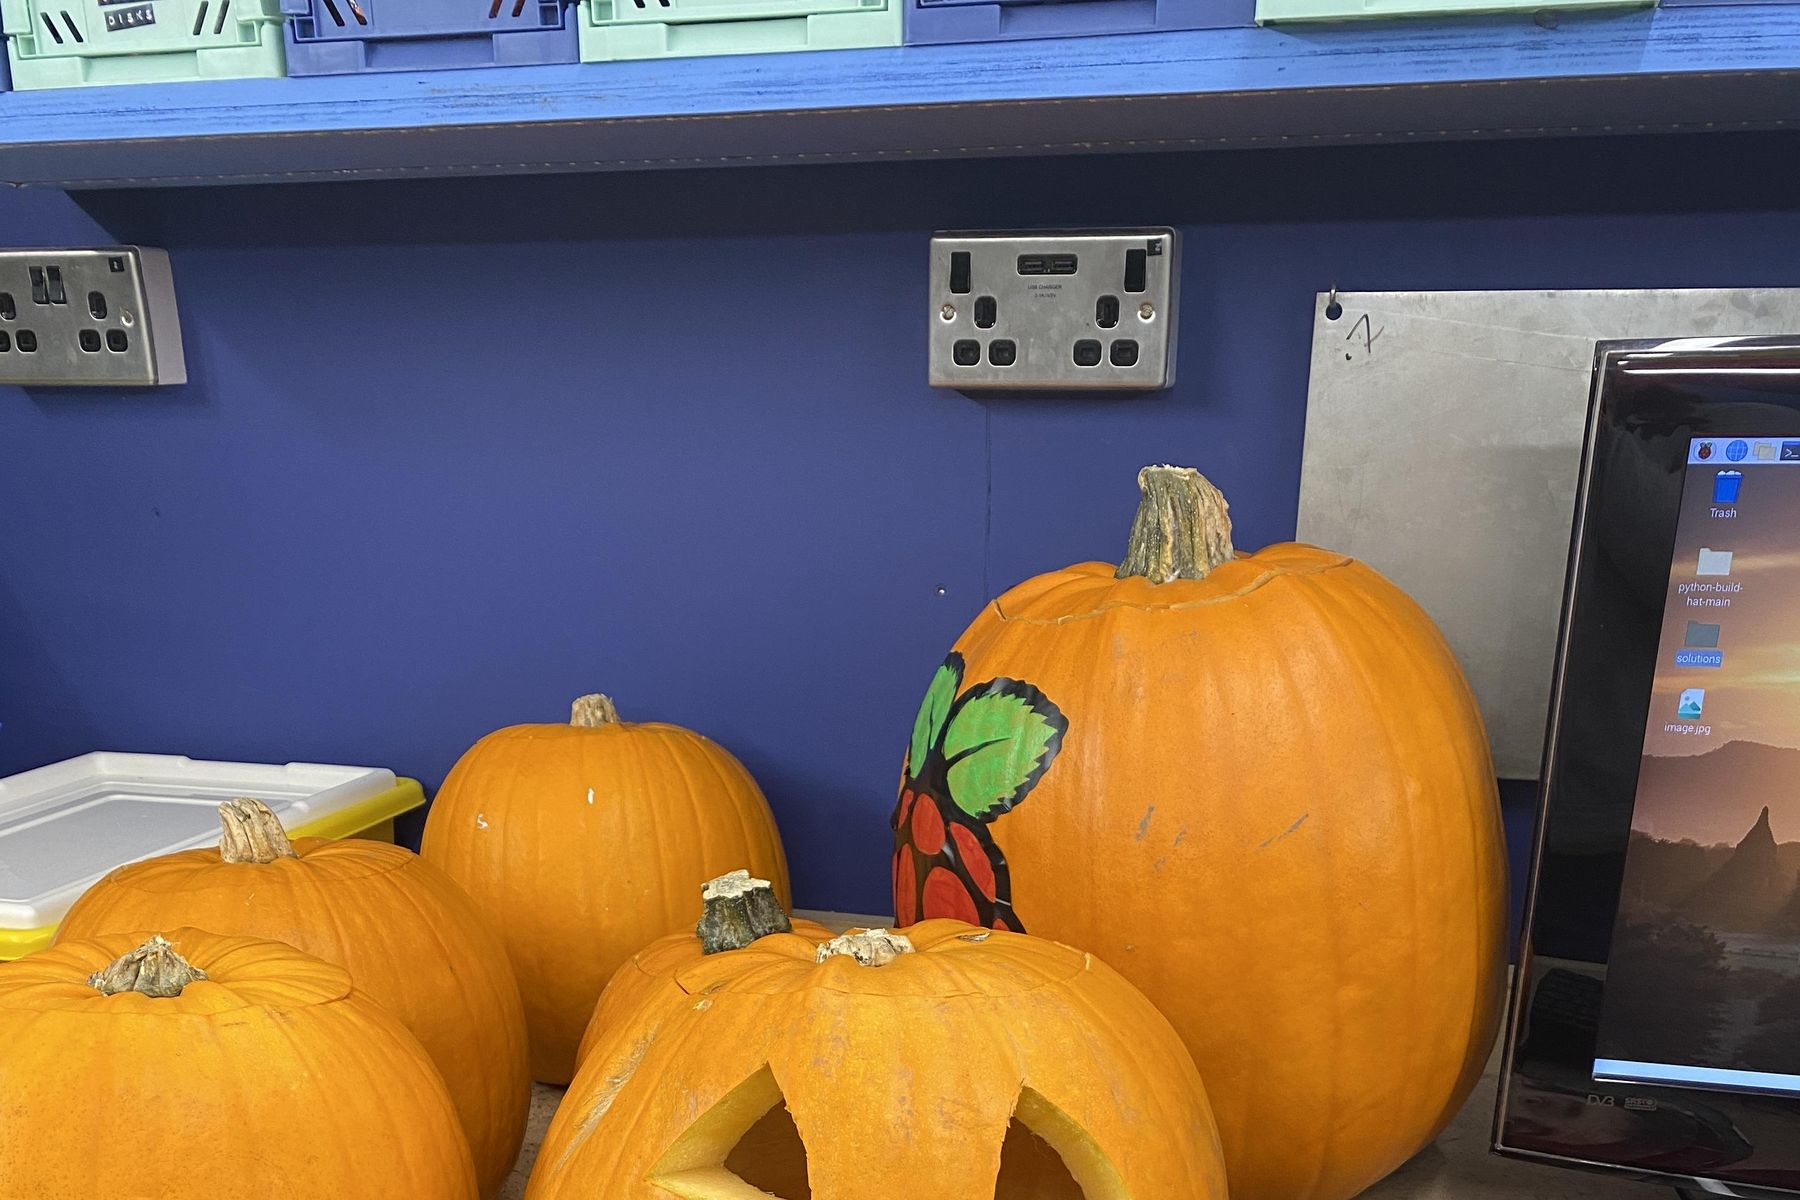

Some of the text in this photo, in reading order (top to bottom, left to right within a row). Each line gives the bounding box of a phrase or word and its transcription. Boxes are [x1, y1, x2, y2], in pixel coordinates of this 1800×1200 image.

[107, 9, 153, 26] DISKS
[1709, 507, 1737, 518] Trash
[1678, 582, 1743, 594] python-build-
[1686, 596, 1731, 607] hat-main
[1676, 653, 1721, 664] solutions
[1664, 722, 1711, 736] image.jpg
[1586, 1094, 1615, 1107] DVB
